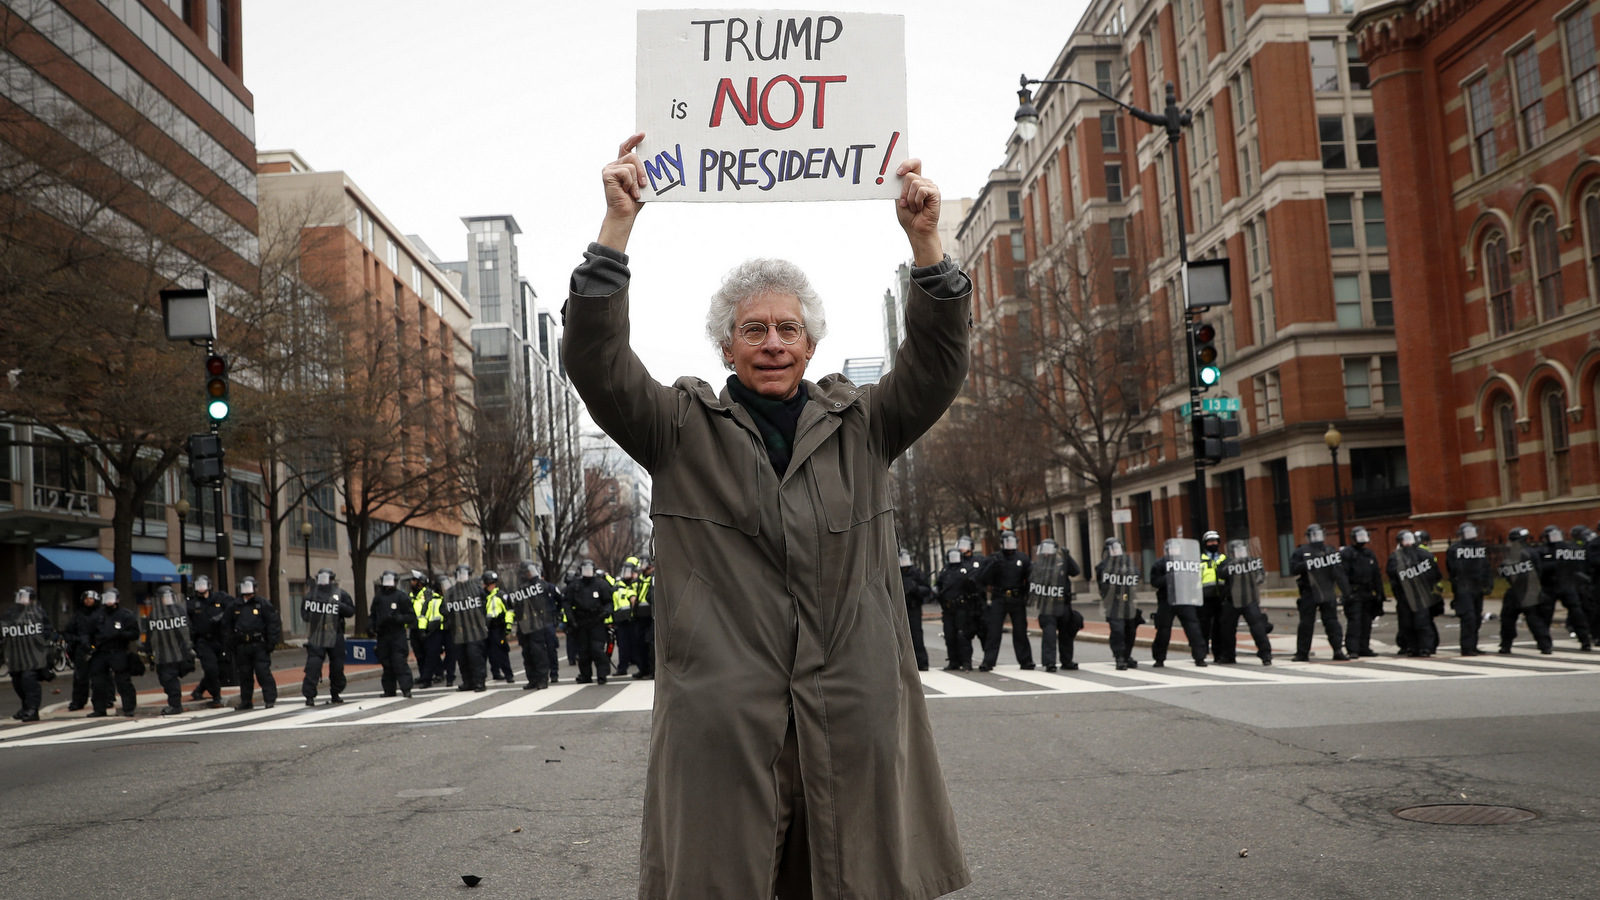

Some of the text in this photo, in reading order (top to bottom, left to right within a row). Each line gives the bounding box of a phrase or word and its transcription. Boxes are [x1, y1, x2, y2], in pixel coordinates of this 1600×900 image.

[691, 16, 843, 61] TRUMP
[671, 74, 848, 130] is NOT
[644, 144, 686, 195] MY
[35, 488, 90, 518] 1275
[1307, 552, 1341, 570] POLICE
[1457, 547, 1486, 559] POLICE
[1556, 549, 1586, 560] POLICE
[1166, 560, 1200, 573] POLICE
[1228, 558, 1263, 575] POLICE
[1399, 559, 1432, 580] POLICE
[1103, 573, 1139, 587] POLICE
[509, 583, 544, 603] POLICE
[1029, 583, 1064, 598] POLICE
[305, 600, 339, 615] POLICE
[447, 597, 481, 612] POLICE
[2, 622, 42, 637] POLICE
[149, 615, 187, 632] POLICE
